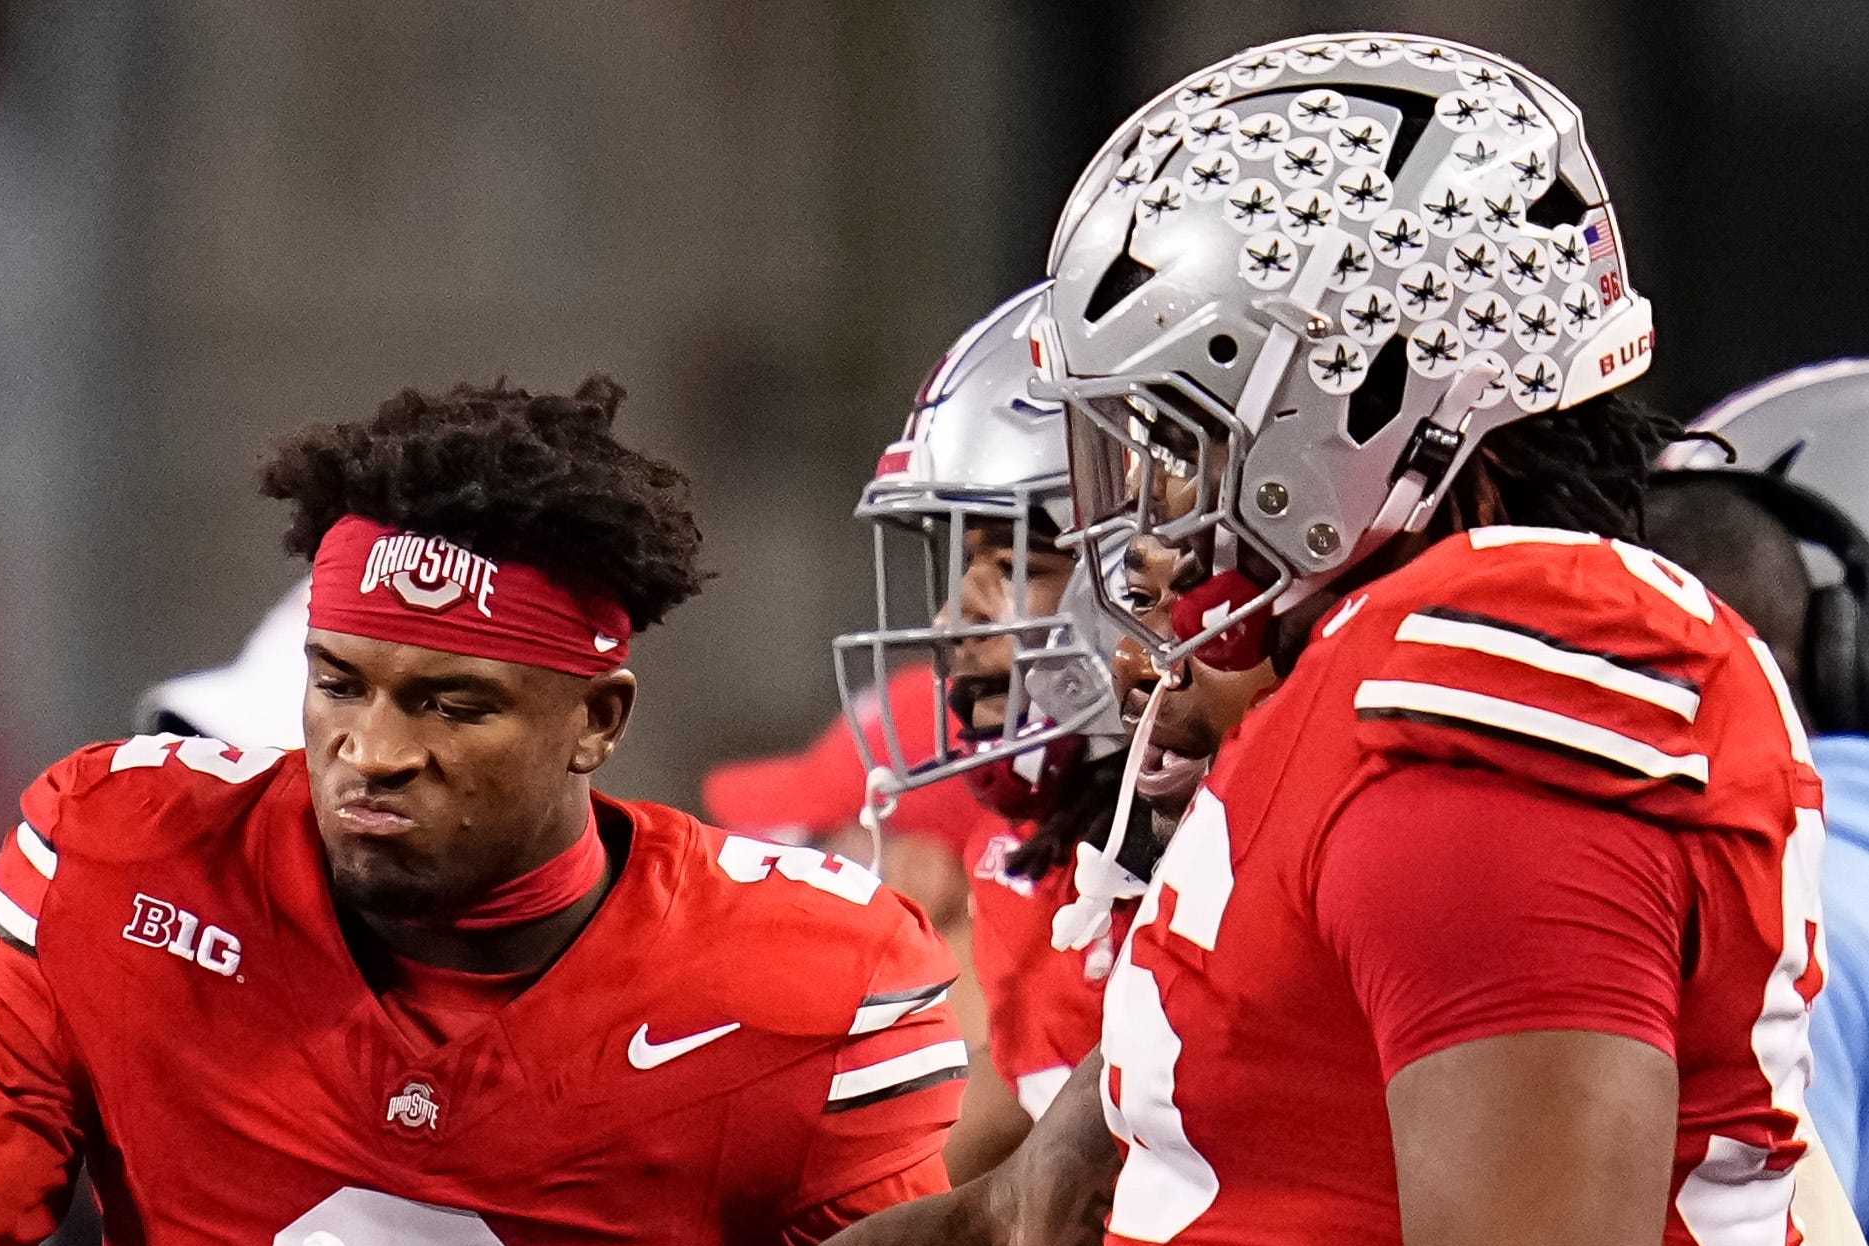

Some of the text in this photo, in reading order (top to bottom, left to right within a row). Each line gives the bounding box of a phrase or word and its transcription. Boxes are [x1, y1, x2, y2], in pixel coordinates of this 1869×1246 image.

[1600, 271, 1621, 307] 96
[360, 532, 426, 594] OHIO
[122, 892, 243, 977] BIG
